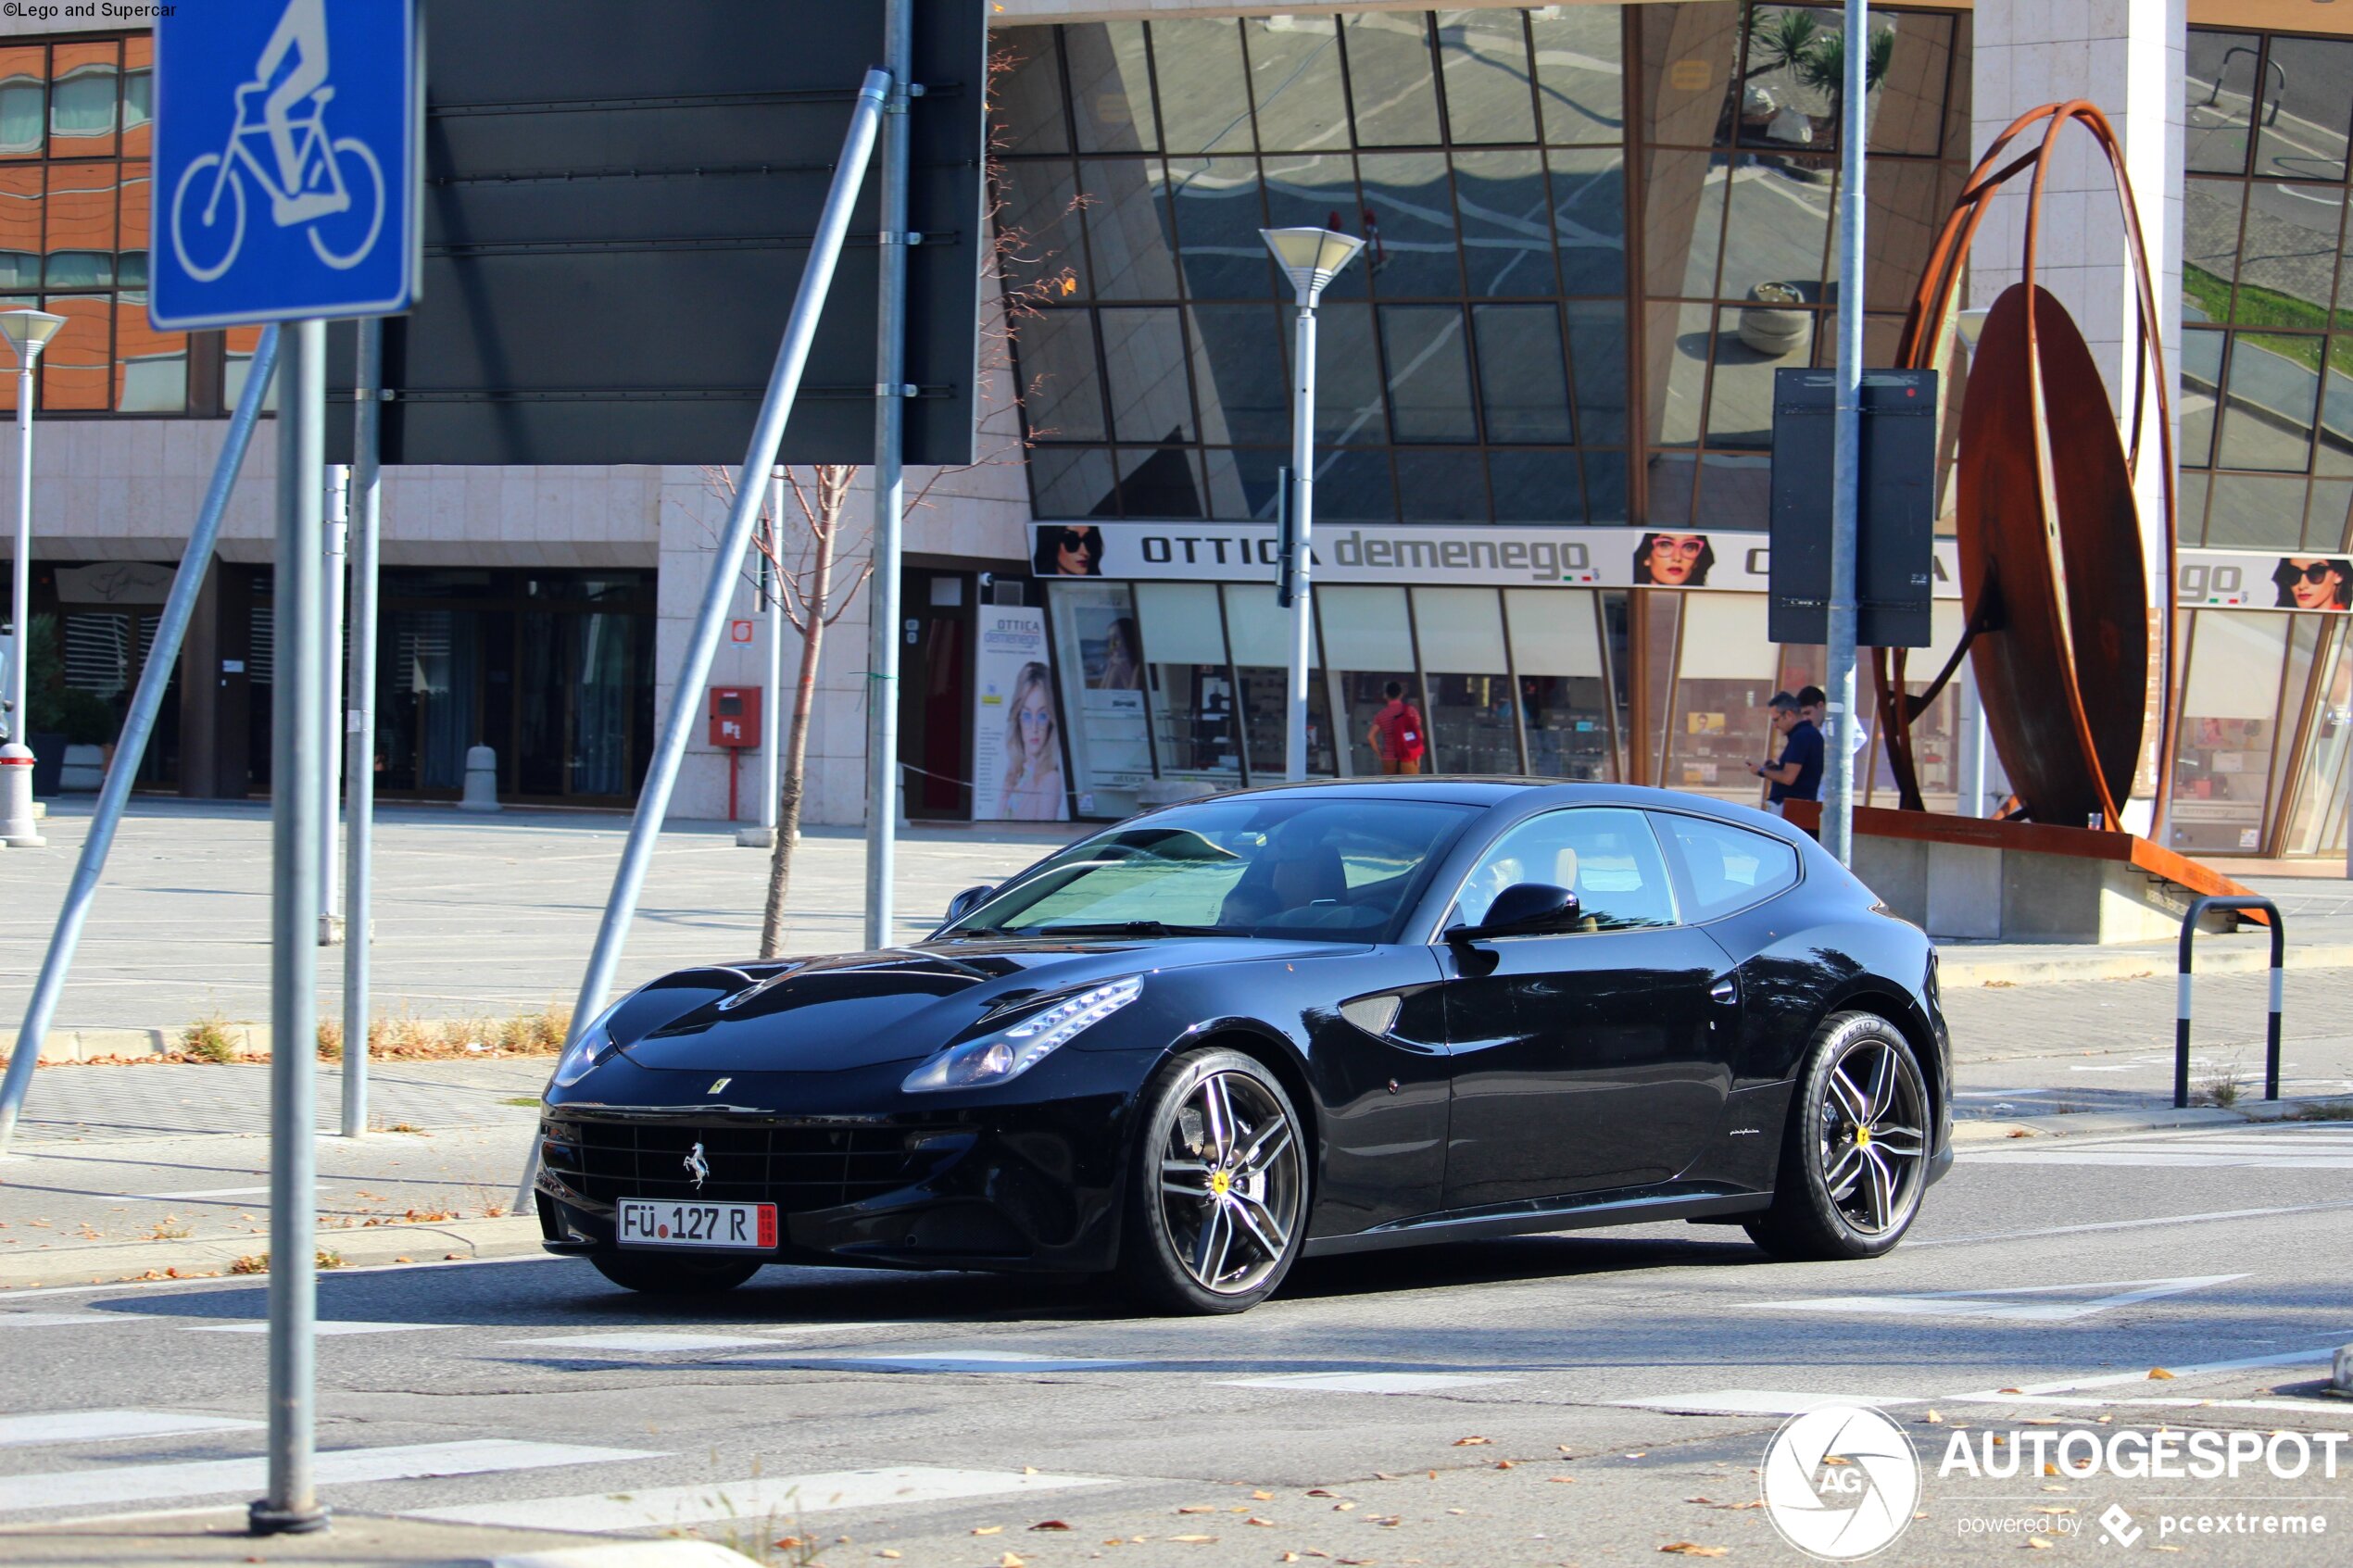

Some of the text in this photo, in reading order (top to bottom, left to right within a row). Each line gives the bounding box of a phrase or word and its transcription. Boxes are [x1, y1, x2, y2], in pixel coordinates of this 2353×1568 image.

[1334, 531, 1590, 581] demenego
[997, 620, 1039, 631] OTTICA
[1842, 1022, 1872, 1044] ZERO
[672, 1207, 720, 1240] 127
[730, 1209, 747, 1241] R
